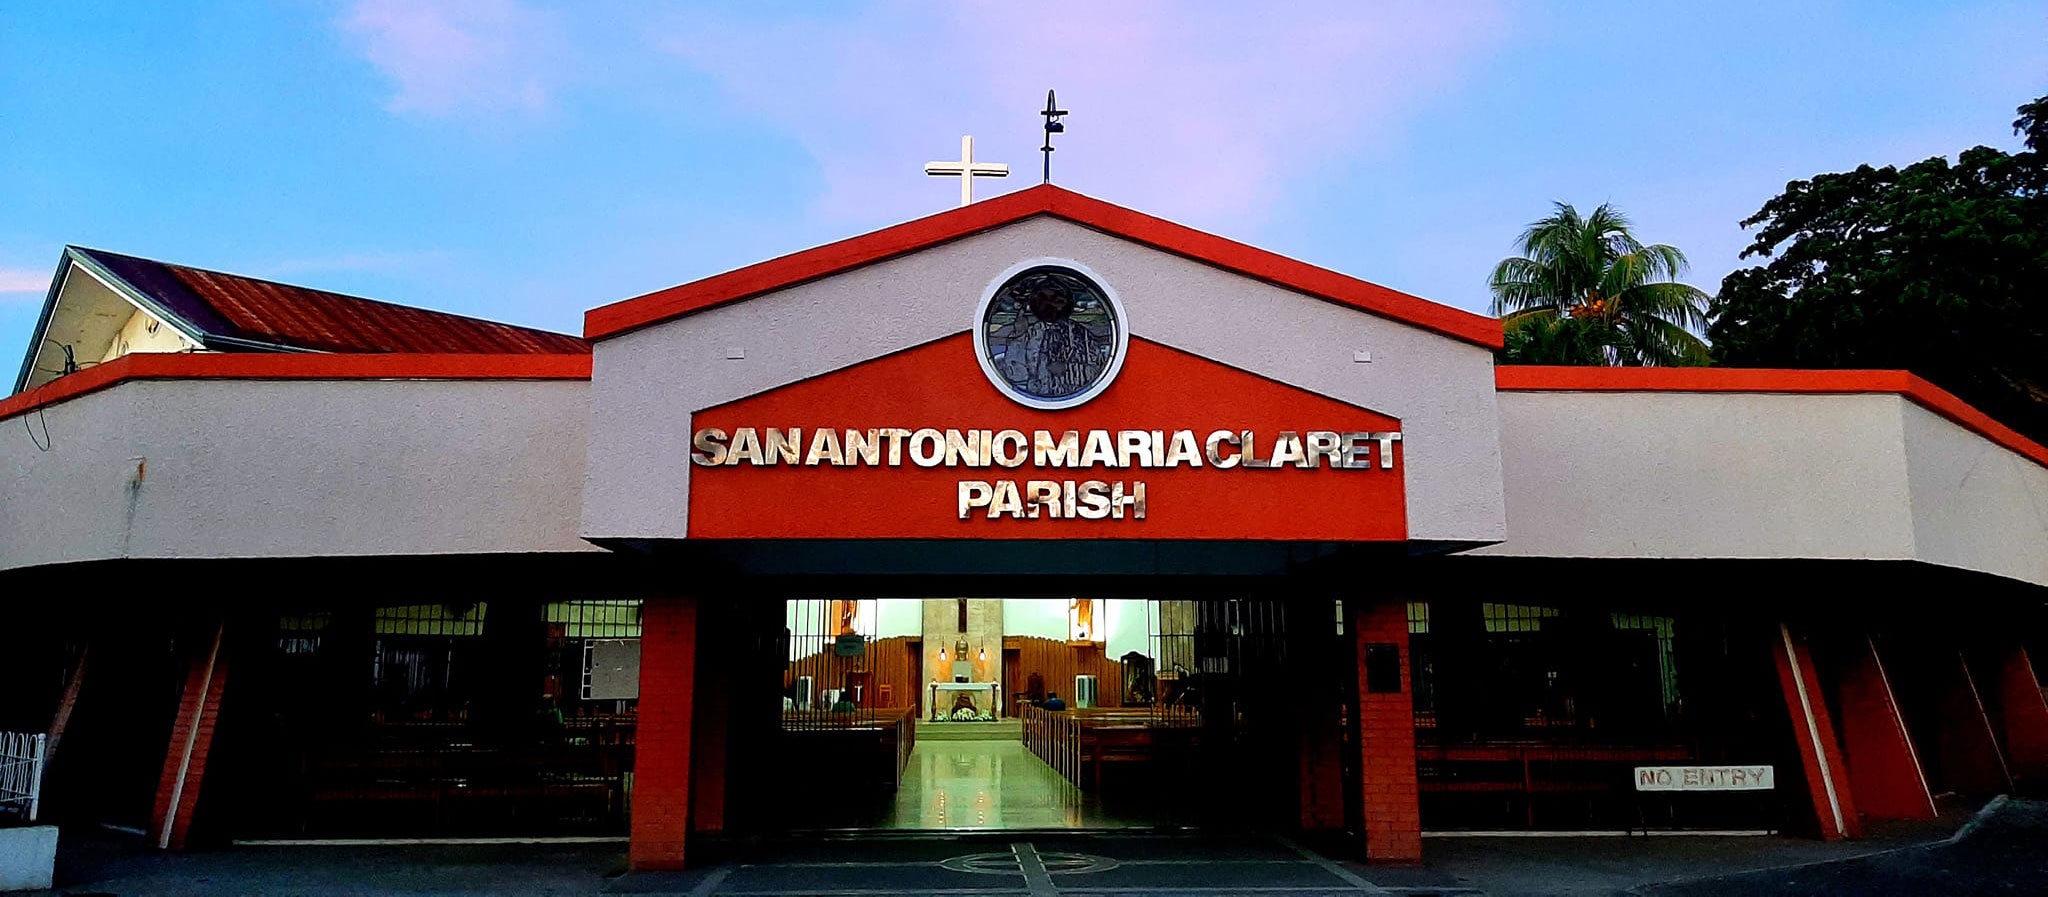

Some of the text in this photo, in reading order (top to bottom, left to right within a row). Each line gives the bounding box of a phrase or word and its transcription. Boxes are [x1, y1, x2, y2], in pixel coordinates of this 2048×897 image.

[691, 427, 1402, 468] SAN ANTONIO MARIA CLARET
[958, 480, 1146, 519] PARISH
[1640, 768, 1765, 786] NO ENTRY
